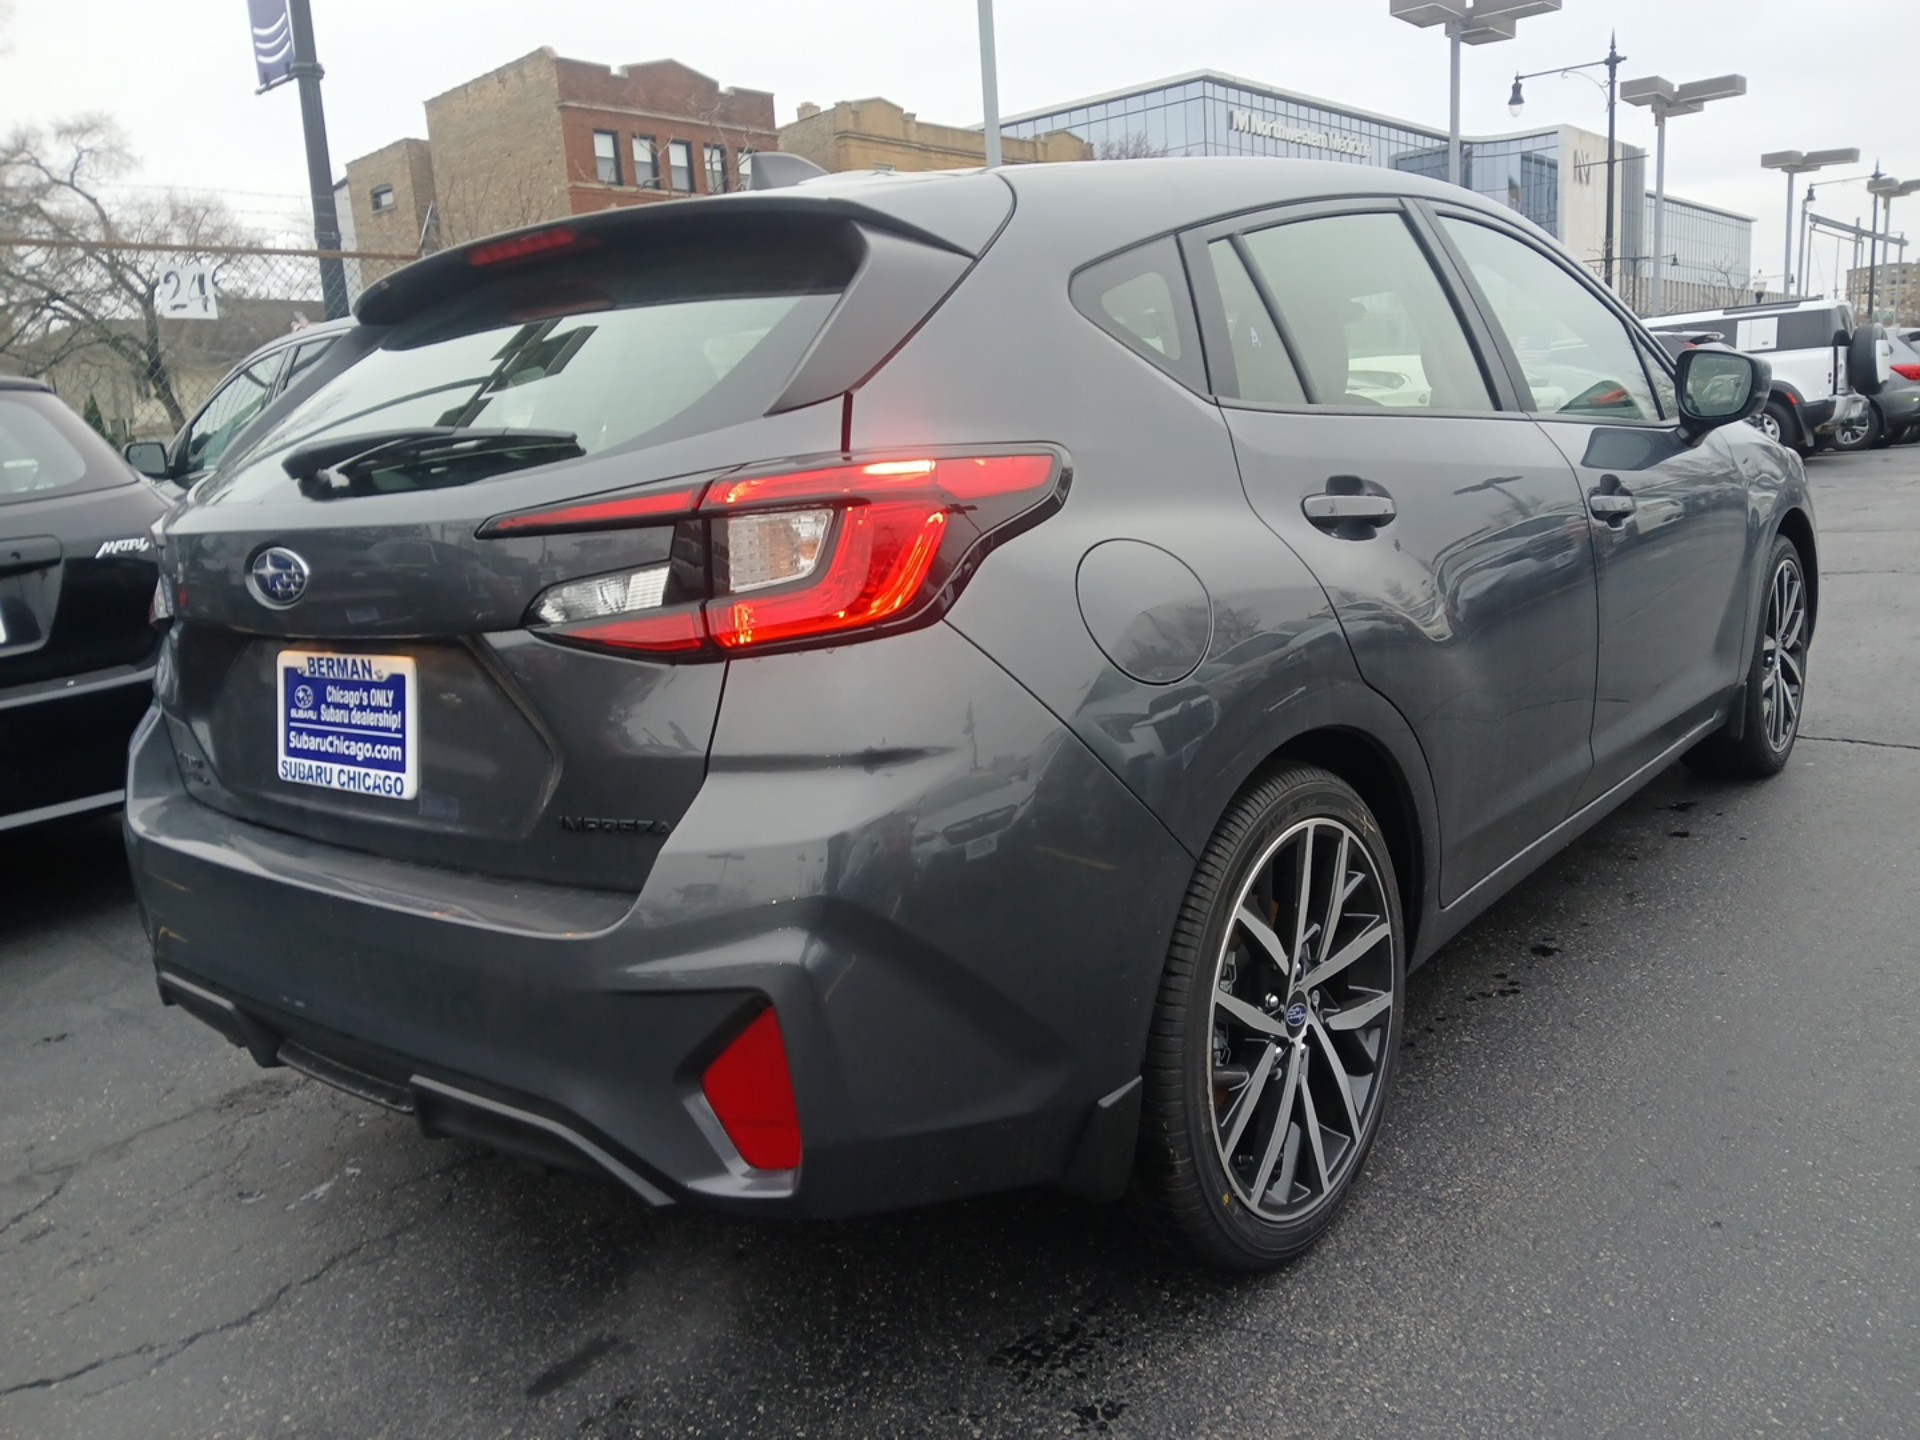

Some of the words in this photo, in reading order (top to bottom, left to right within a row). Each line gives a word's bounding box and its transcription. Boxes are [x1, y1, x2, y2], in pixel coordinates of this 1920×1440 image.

[1251, 114, 1328, 149] Northwestern
[1328, 131, 1371, 158] Medicine
[163, 270, 210, 313] 24
[306, 656, 373, 680] BERMAN
[326, 684, 369, 709] Chicago's
[370, 688, 395, 708] ONLY
[320, 703, 349, 723] Subaru
[350, 707, 401, 732] dealership!
[289, 731, 402, 761] SubaruChicago.com
[281, 760, 333, 785] SUBARU
[337, 768, 405, 797] CHICAGO
